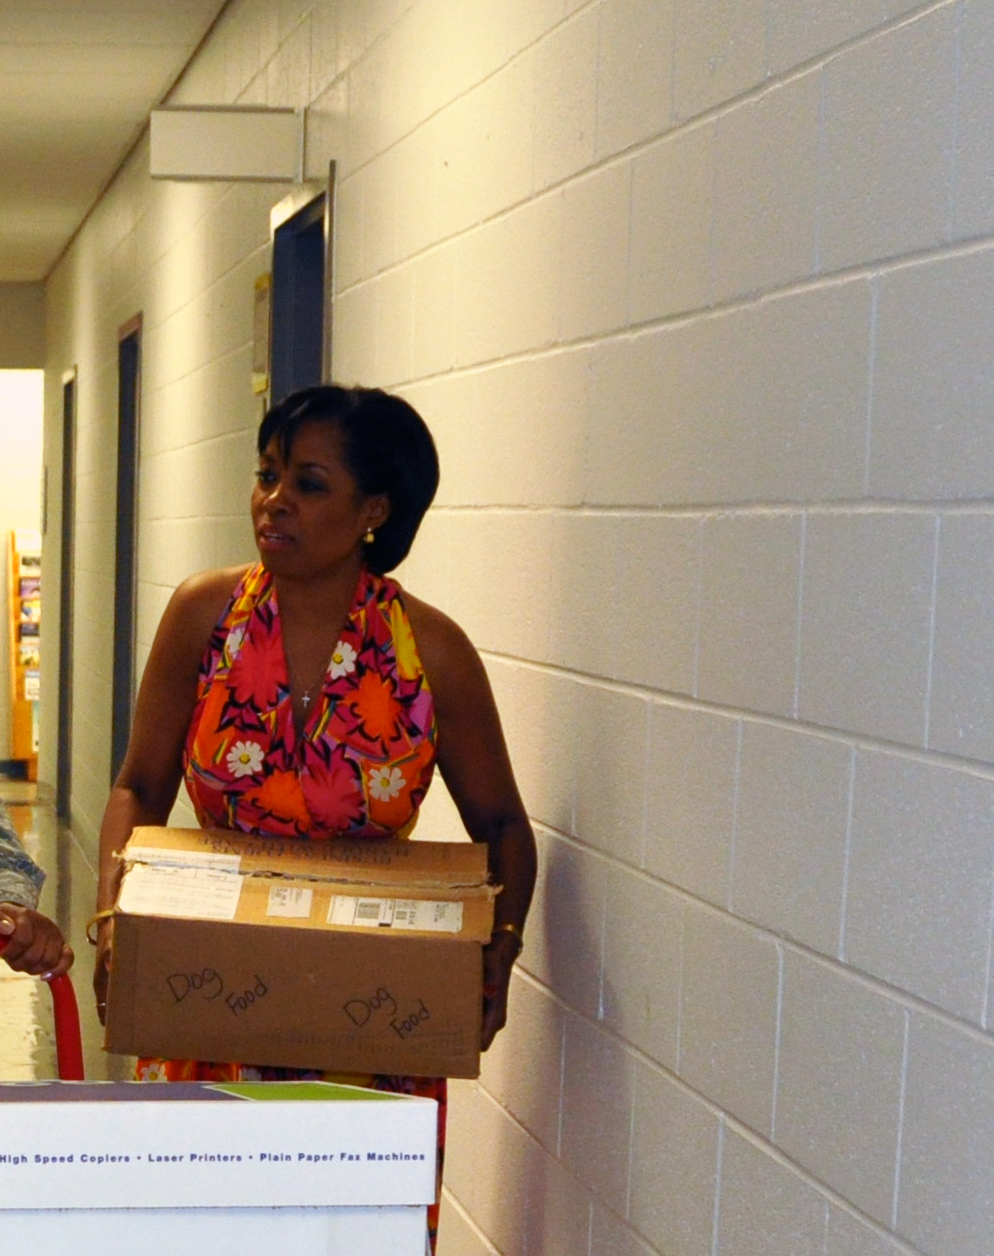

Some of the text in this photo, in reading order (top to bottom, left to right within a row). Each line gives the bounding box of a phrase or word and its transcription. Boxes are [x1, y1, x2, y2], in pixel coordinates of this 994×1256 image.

[166, 968, 223, 1003] Dog
[225, 974, 268, 1016] Food
[343, 988, 397, 1027] Dog
[390, 998, 430, 1040] Food
[0, 1153, 28, 1165] High
[34, 1153, 74, 1165] Speed
[80, 1153, 130, 1164] Copiers
[148, 1153, 184, 1162] Laser
[190, 1152, 242, 1162] Printers
[260, 1152, 292, 1162] Plain
[298, 1152, 334, 1163] Paper
[340, 1152, 361, 1161] Fax
[367, 1151, 425, 1161] Machines
